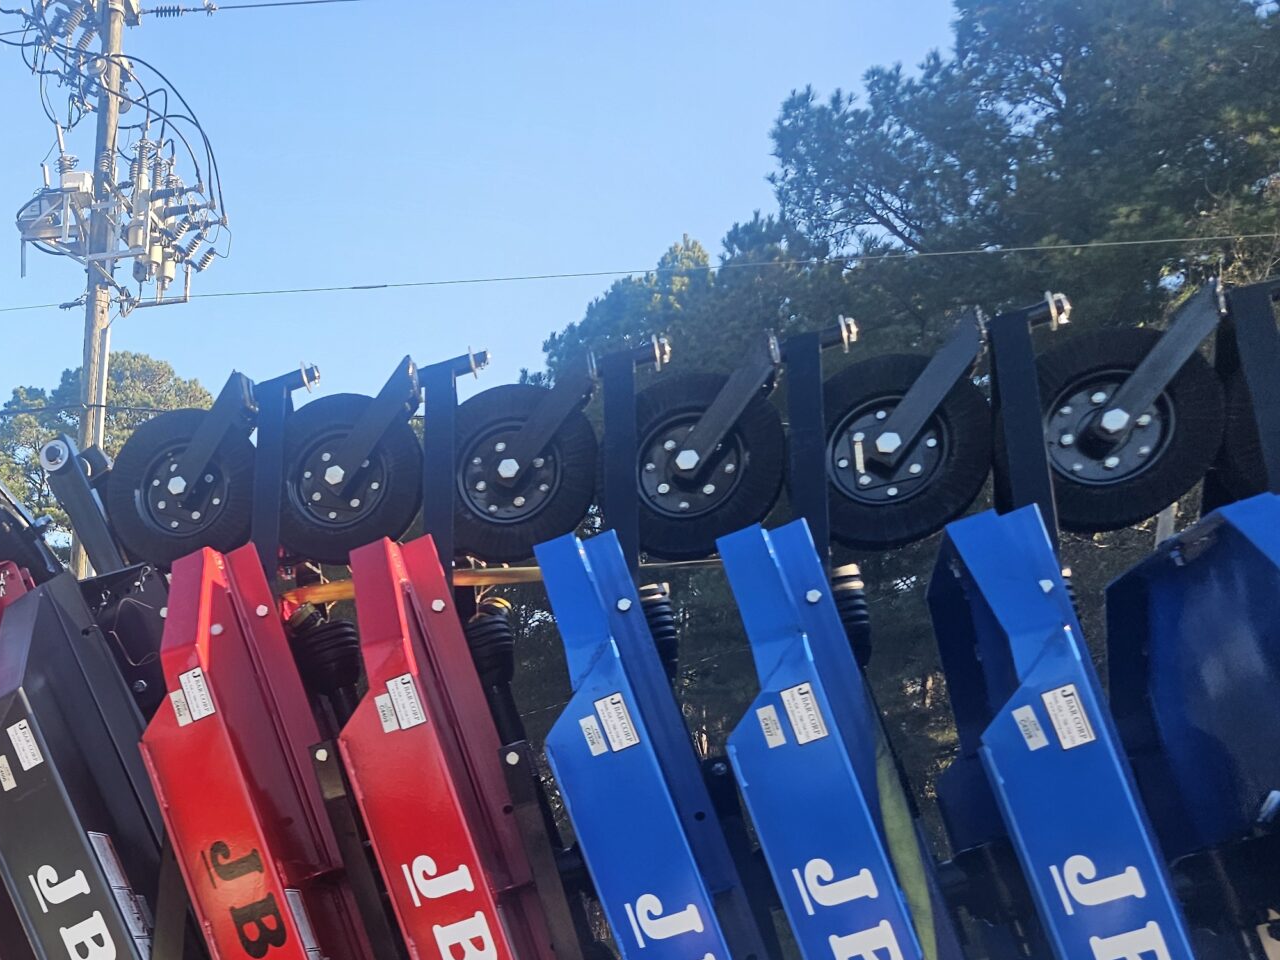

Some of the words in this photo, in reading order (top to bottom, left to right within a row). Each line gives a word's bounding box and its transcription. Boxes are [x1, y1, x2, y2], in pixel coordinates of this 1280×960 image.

[191, 670, 200, 679] J
[399, 676, 410, 686] J
[796, 685, 809, 697] J
[1060, 687, 1074, 699] J
[609, 695, 621, 706] J
[801, 696, 811, 713] BAR
[1065, 698, 1077, 716] BAR
[614, 705, 624, 721] BAR
[17, 722, 26, 731] J
[209, 840, 264, 881] J
[37, 865, 91, 904] J
[411, 855, 476, 900] J
[804, 858, 879, 908] J
[1061, 854, 1147, 908] J
[634, 893, 704, 941] J
